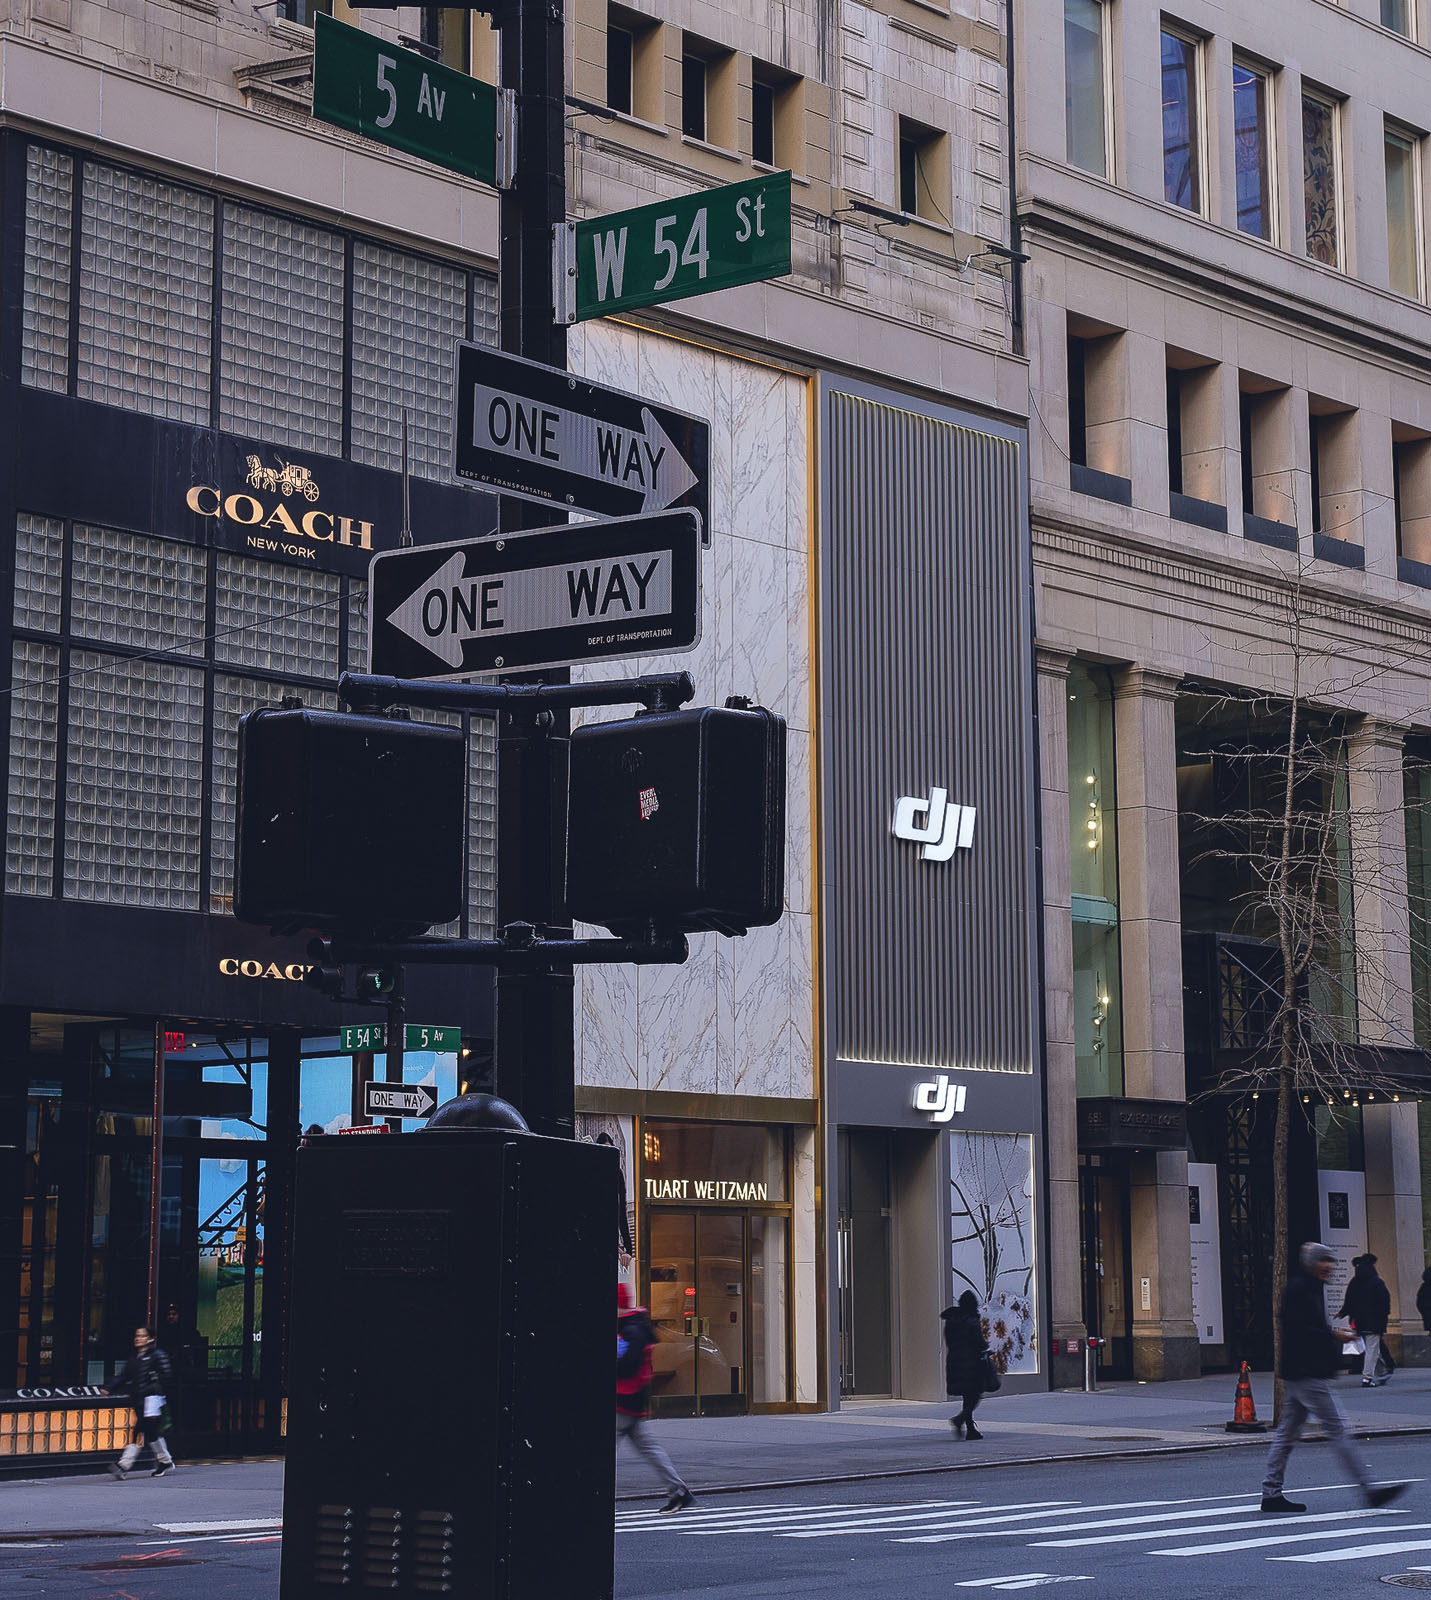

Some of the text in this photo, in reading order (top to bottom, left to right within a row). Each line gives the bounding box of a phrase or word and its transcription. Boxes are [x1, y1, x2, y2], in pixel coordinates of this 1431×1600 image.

[376, 53, 446, 128] 5 Av
[593, 193, 766, 301] W 54 St
[488, 396, 666, 490] ONE WAY
[493, 477, 552, 498] TRANSPORTATION
[186, 486, 375, 551] COACH
[247, 535, 316, 559] NEW YORK
[422, 558, 660, 638] ONE WAY
[587, 628, 672, 646] DEPT. OF TRANSPORTATION
[219, 958, 314, 981] COAC
[346, 1027, 382, 1048] E 54 St
[421, 1029, 444, 1048] 5 Av
[373, 1093, 425, 1108] ONE WAY
[644, 1179, 768, 1201] TUART WEITZMAN
[16, 1385, 101, 1399] COACH
